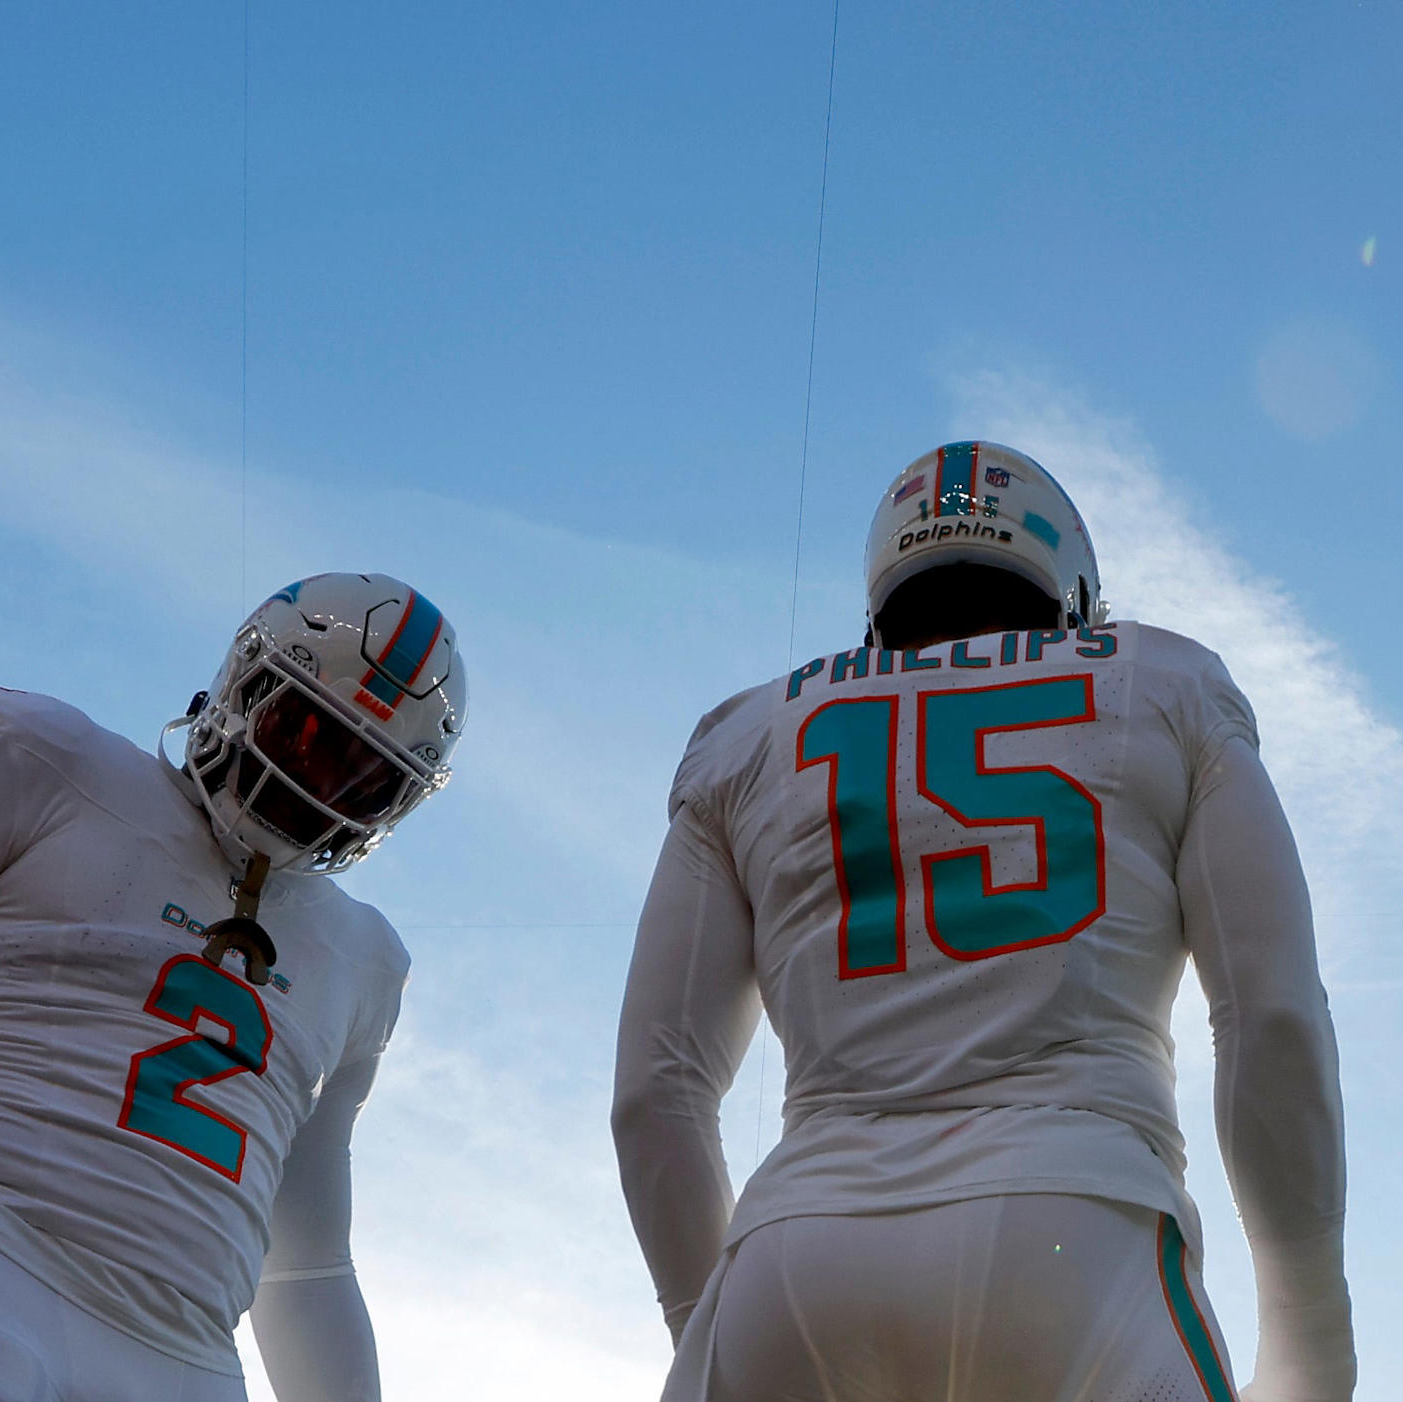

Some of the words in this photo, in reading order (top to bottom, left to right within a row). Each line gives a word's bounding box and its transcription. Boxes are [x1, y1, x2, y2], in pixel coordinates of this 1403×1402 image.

[899, 520, 1013, 551] Dolphins
[786, 622, 1118, 702] PHILLIPS
[795, 672, 1107, 982] 15
[117, 952, 273, 1185] 2
